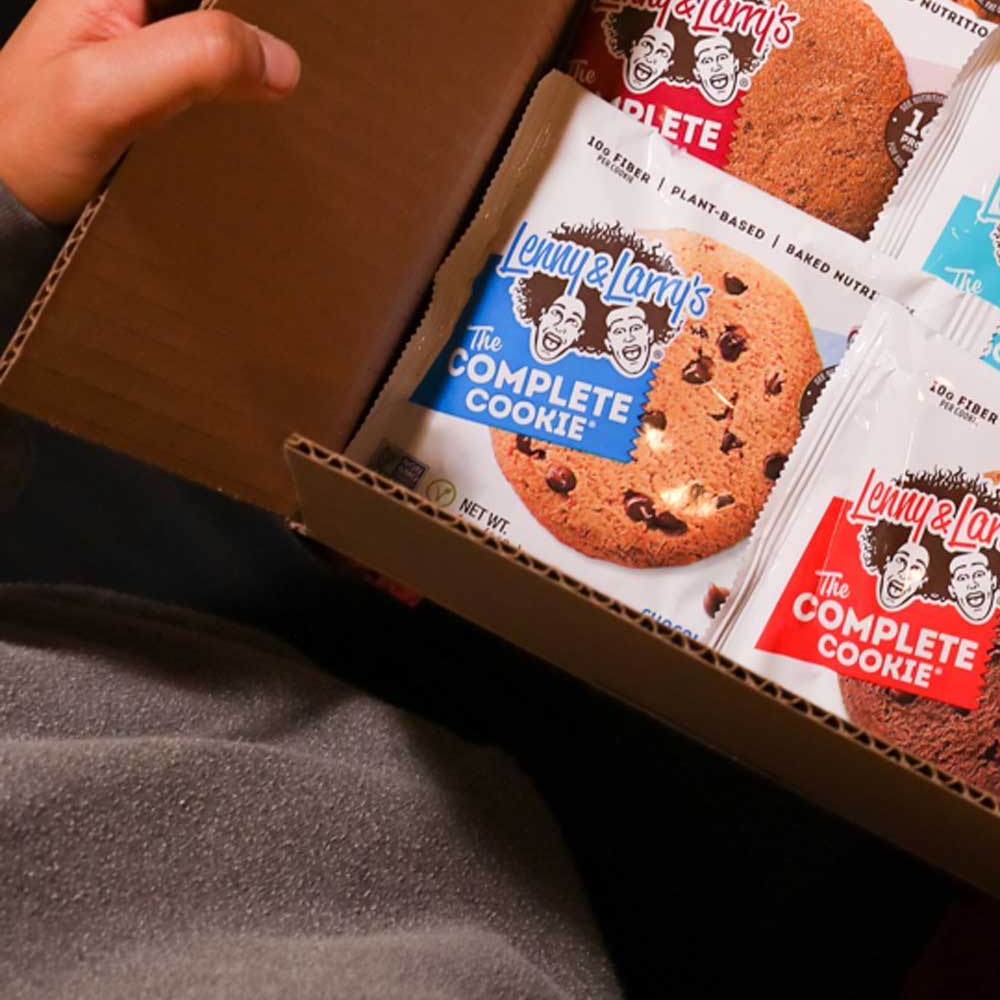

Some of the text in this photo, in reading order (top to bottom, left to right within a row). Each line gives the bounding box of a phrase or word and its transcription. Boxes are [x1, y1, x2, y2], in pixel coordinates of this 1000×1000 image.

[621, 97, 723, 151] PLETE
[612, 152, 651, 185] FIBER
[670, 185, 767, 240] PLANT-BASED
[785, 243, 831, 274] BAKED
[832, 269, 877, 301] NUTRI
[467, 324, 503, 352] The
[448, 350, 634, 424] COMPLETE
[956, 395, 999, 425] FIBER
[458, 497, 487, 521] NET
[815, 569, 850, 600] The
[792, 592, 980, 671] COMPLETE
